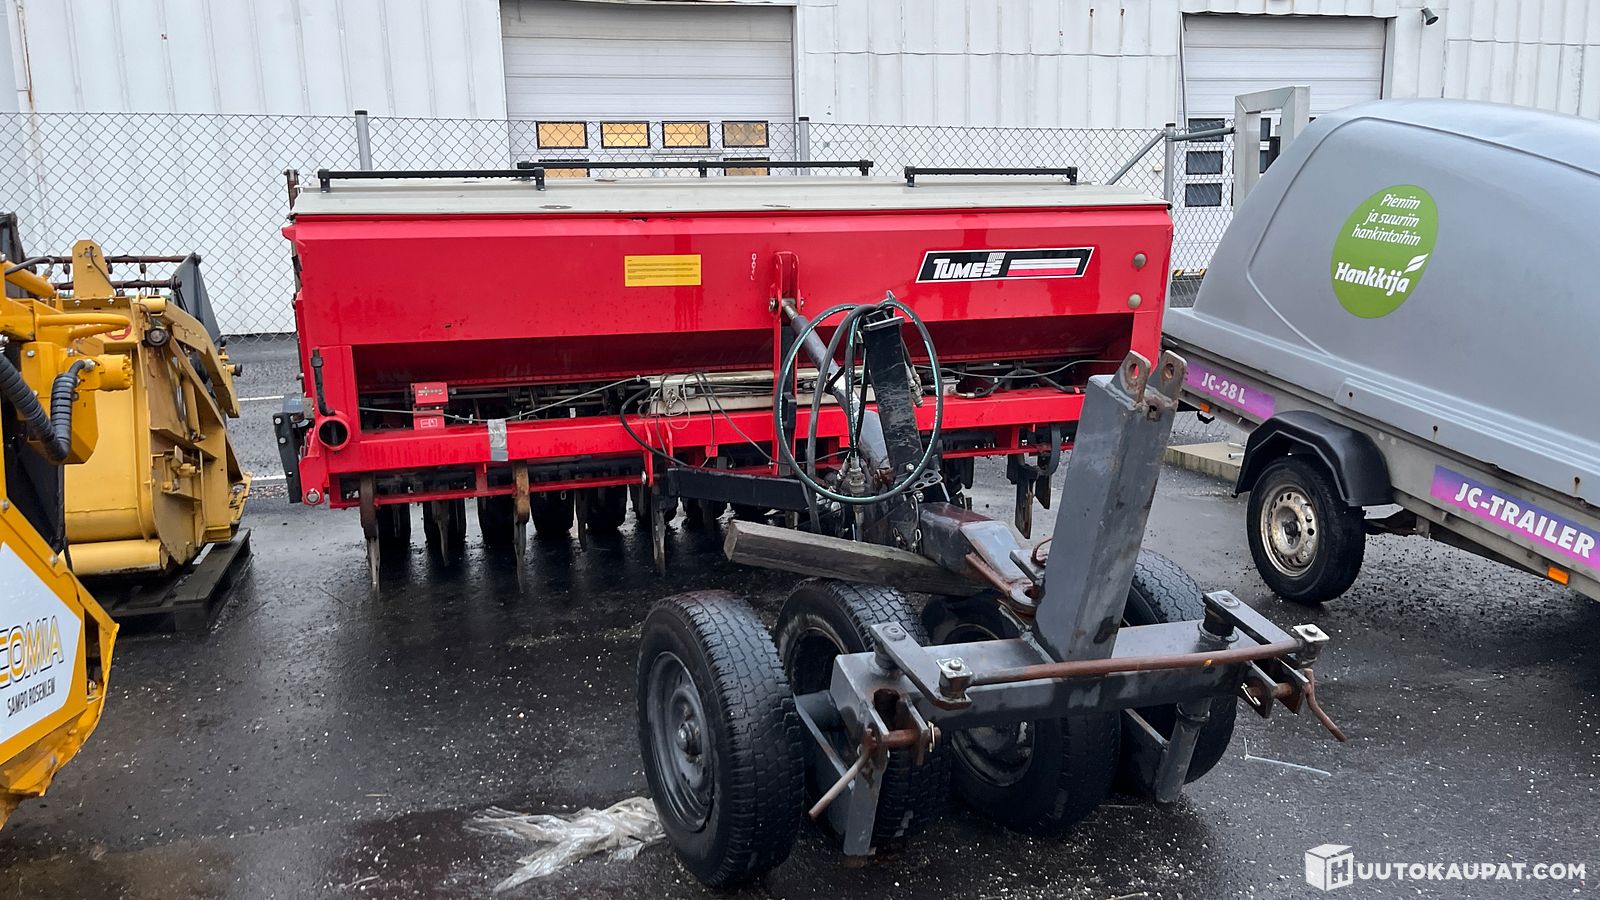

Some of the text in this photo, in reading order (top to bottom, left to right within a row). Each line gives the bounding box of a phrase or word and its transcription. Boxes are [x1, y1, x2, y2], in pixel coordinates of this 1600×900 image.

[1380, 193, 1421, 210] Pieniin
[1362, 209, 1420, 228] ja suuriin
[1352, 224, 1421, 246] hankintoihin
[1334, 262, 1410, 296] Hankkija
[1454, 482, 1595, 559] JC-TRAILER
